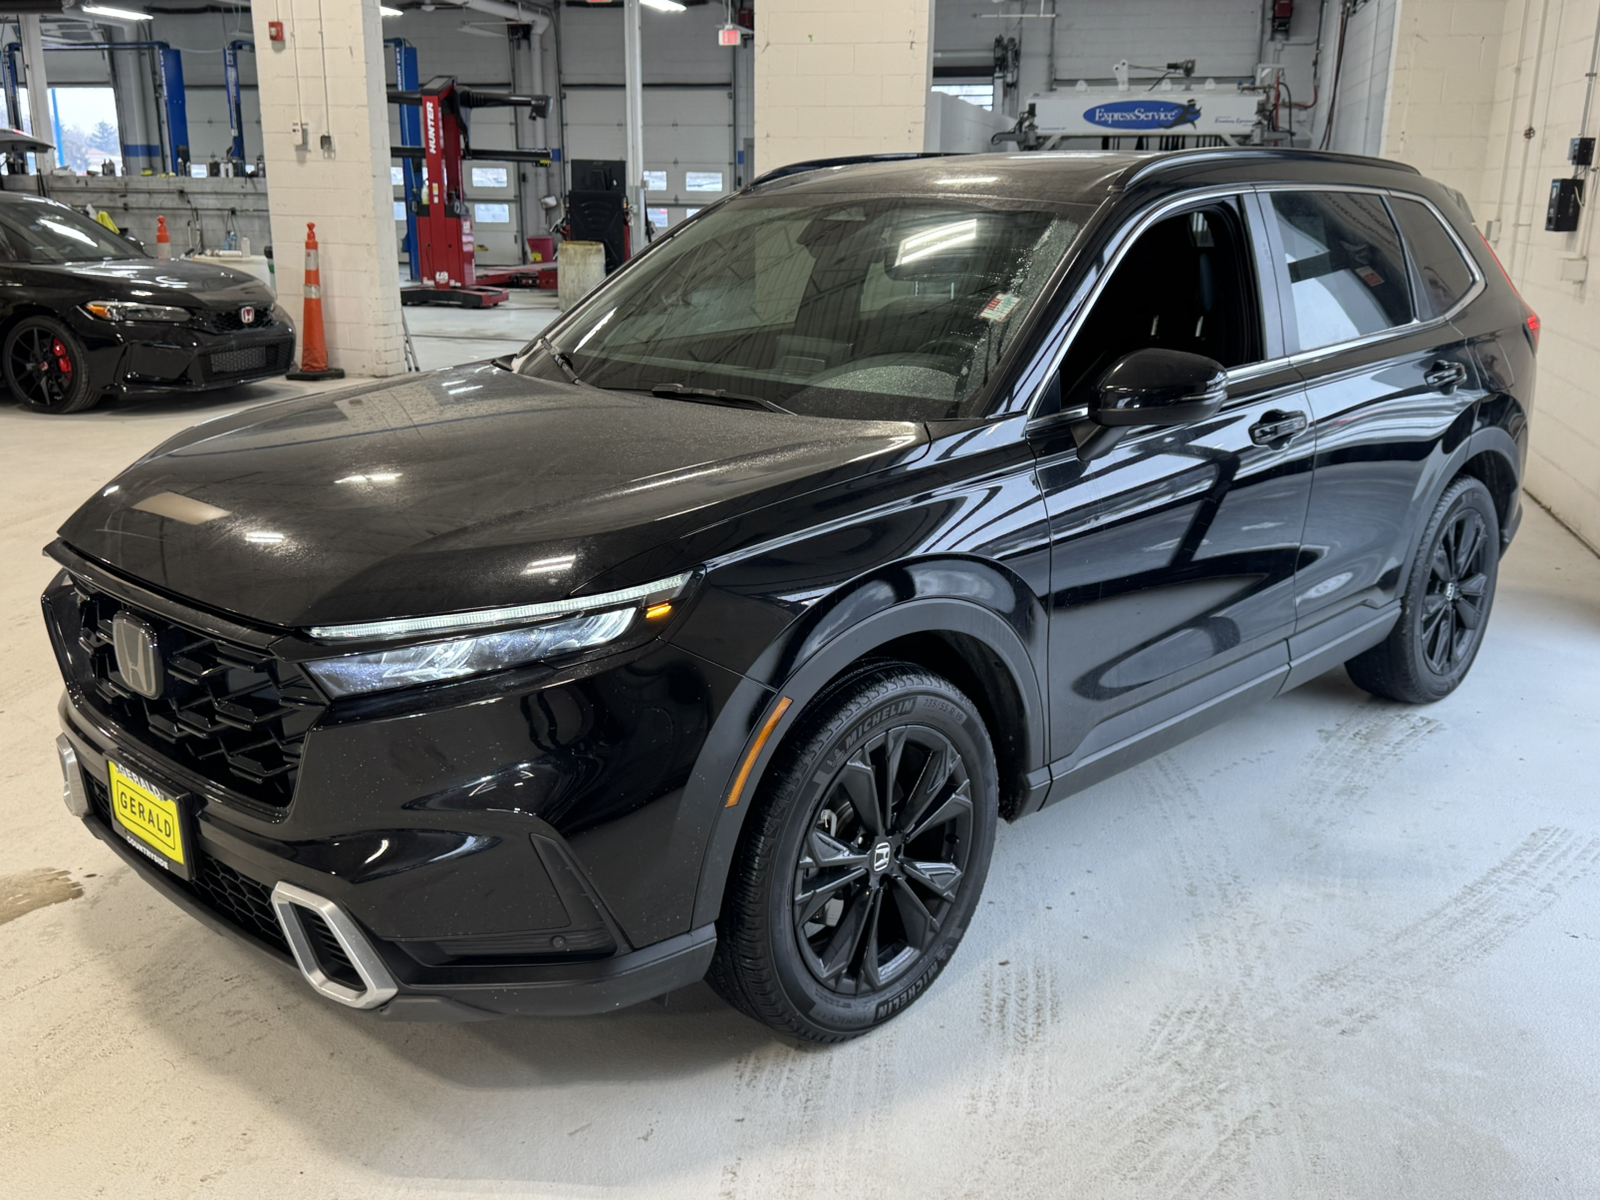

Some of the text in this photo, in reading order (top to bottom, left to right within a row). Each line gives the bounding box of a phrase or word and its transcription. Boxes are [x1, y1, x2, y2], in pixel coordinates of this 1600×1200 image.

[426, 101, 436, 154] HUNTER
[845, 699, 914, 750] MICHELIN
[922, 698, 949, 713] 235/55
[120, 791, 172, 838] GERALD
[877, 961, 939, 1020] MICHELIN
